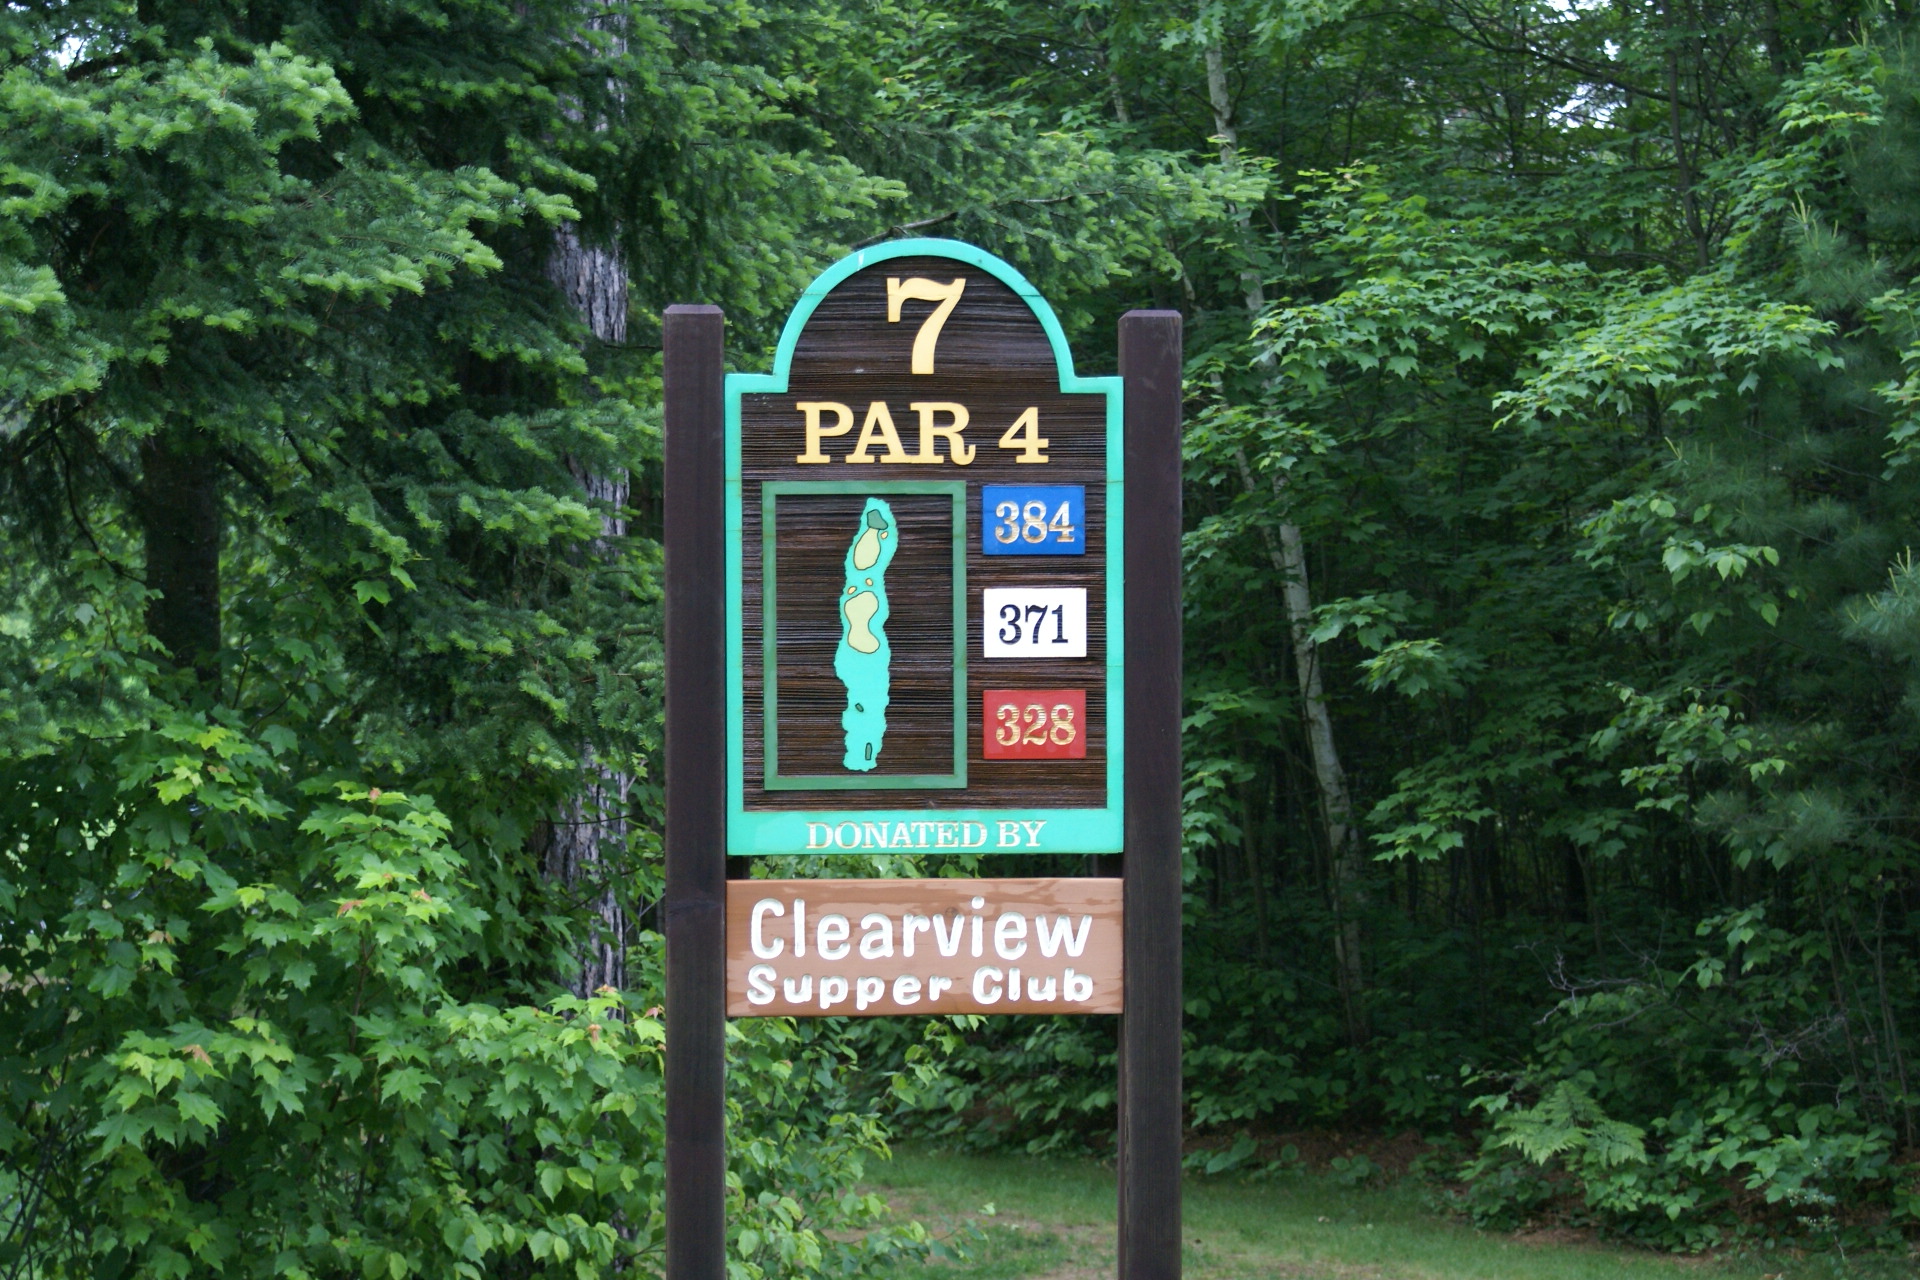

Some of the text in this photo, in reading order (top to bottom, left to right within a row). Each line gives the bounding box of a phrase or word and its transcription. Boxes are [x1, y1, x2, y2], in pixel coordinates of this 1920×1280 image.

[887, 277, 966, 375] 7
[796, 401, 1049, 466] PAR 4
[995, 500, 1075, 544] 384
[999, 604, 1069, 645] 371
[995, 703, 1077, 746] 328
[806, 819, 1047, 849] DONATED BY
[750, 896, 1093, 960] Clearview
[746, 963, 1094, 1010] Supper Club
